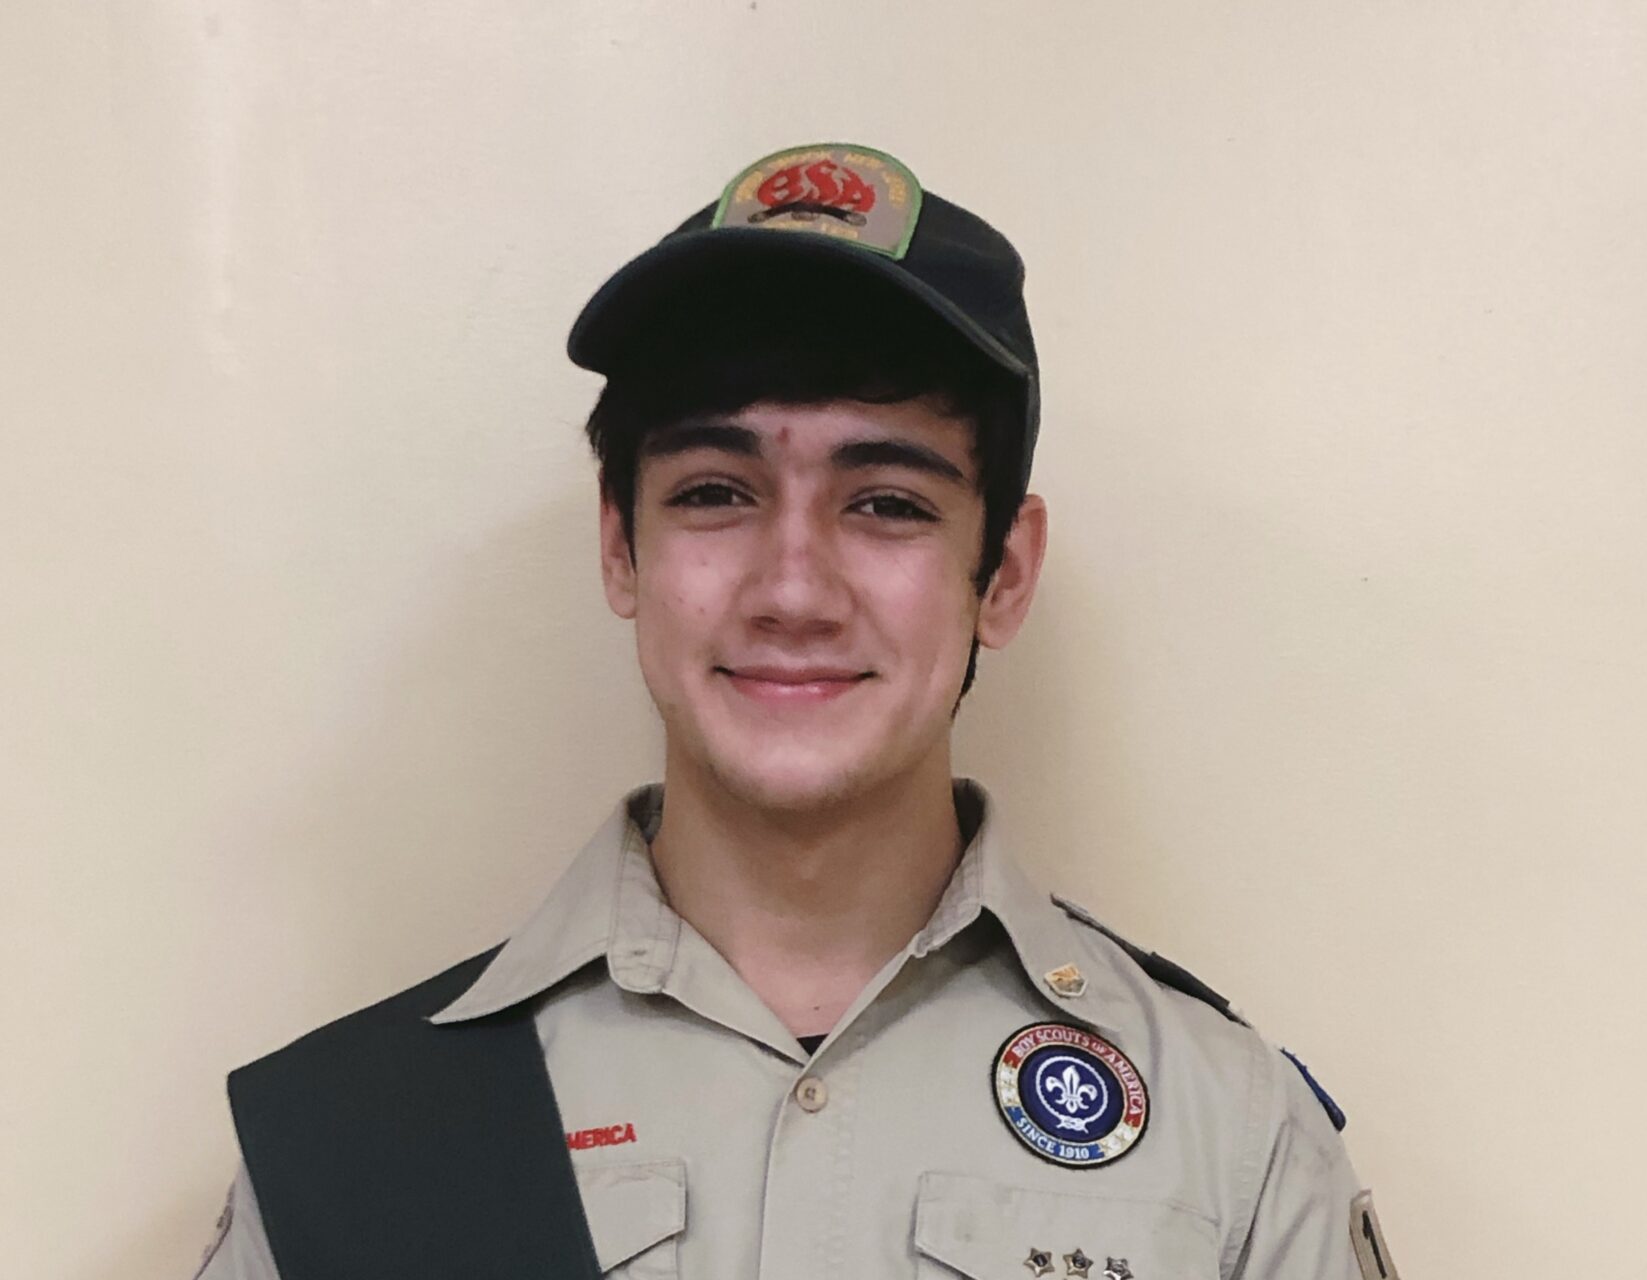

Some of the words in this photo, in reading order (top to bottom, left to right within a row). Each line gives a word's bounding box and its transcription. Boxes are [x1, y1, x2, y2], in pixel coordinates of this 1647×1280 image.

[1011, 1033, 1038, 1058] BOY
[1036, 1029, 1090, 1048] SCOUTS
[1104, 1052, 1143, 1115] AMERICA
[1016, 1117, 1055, 1153] SINCE
[1058, 1146, 1090, 1159] 1910
